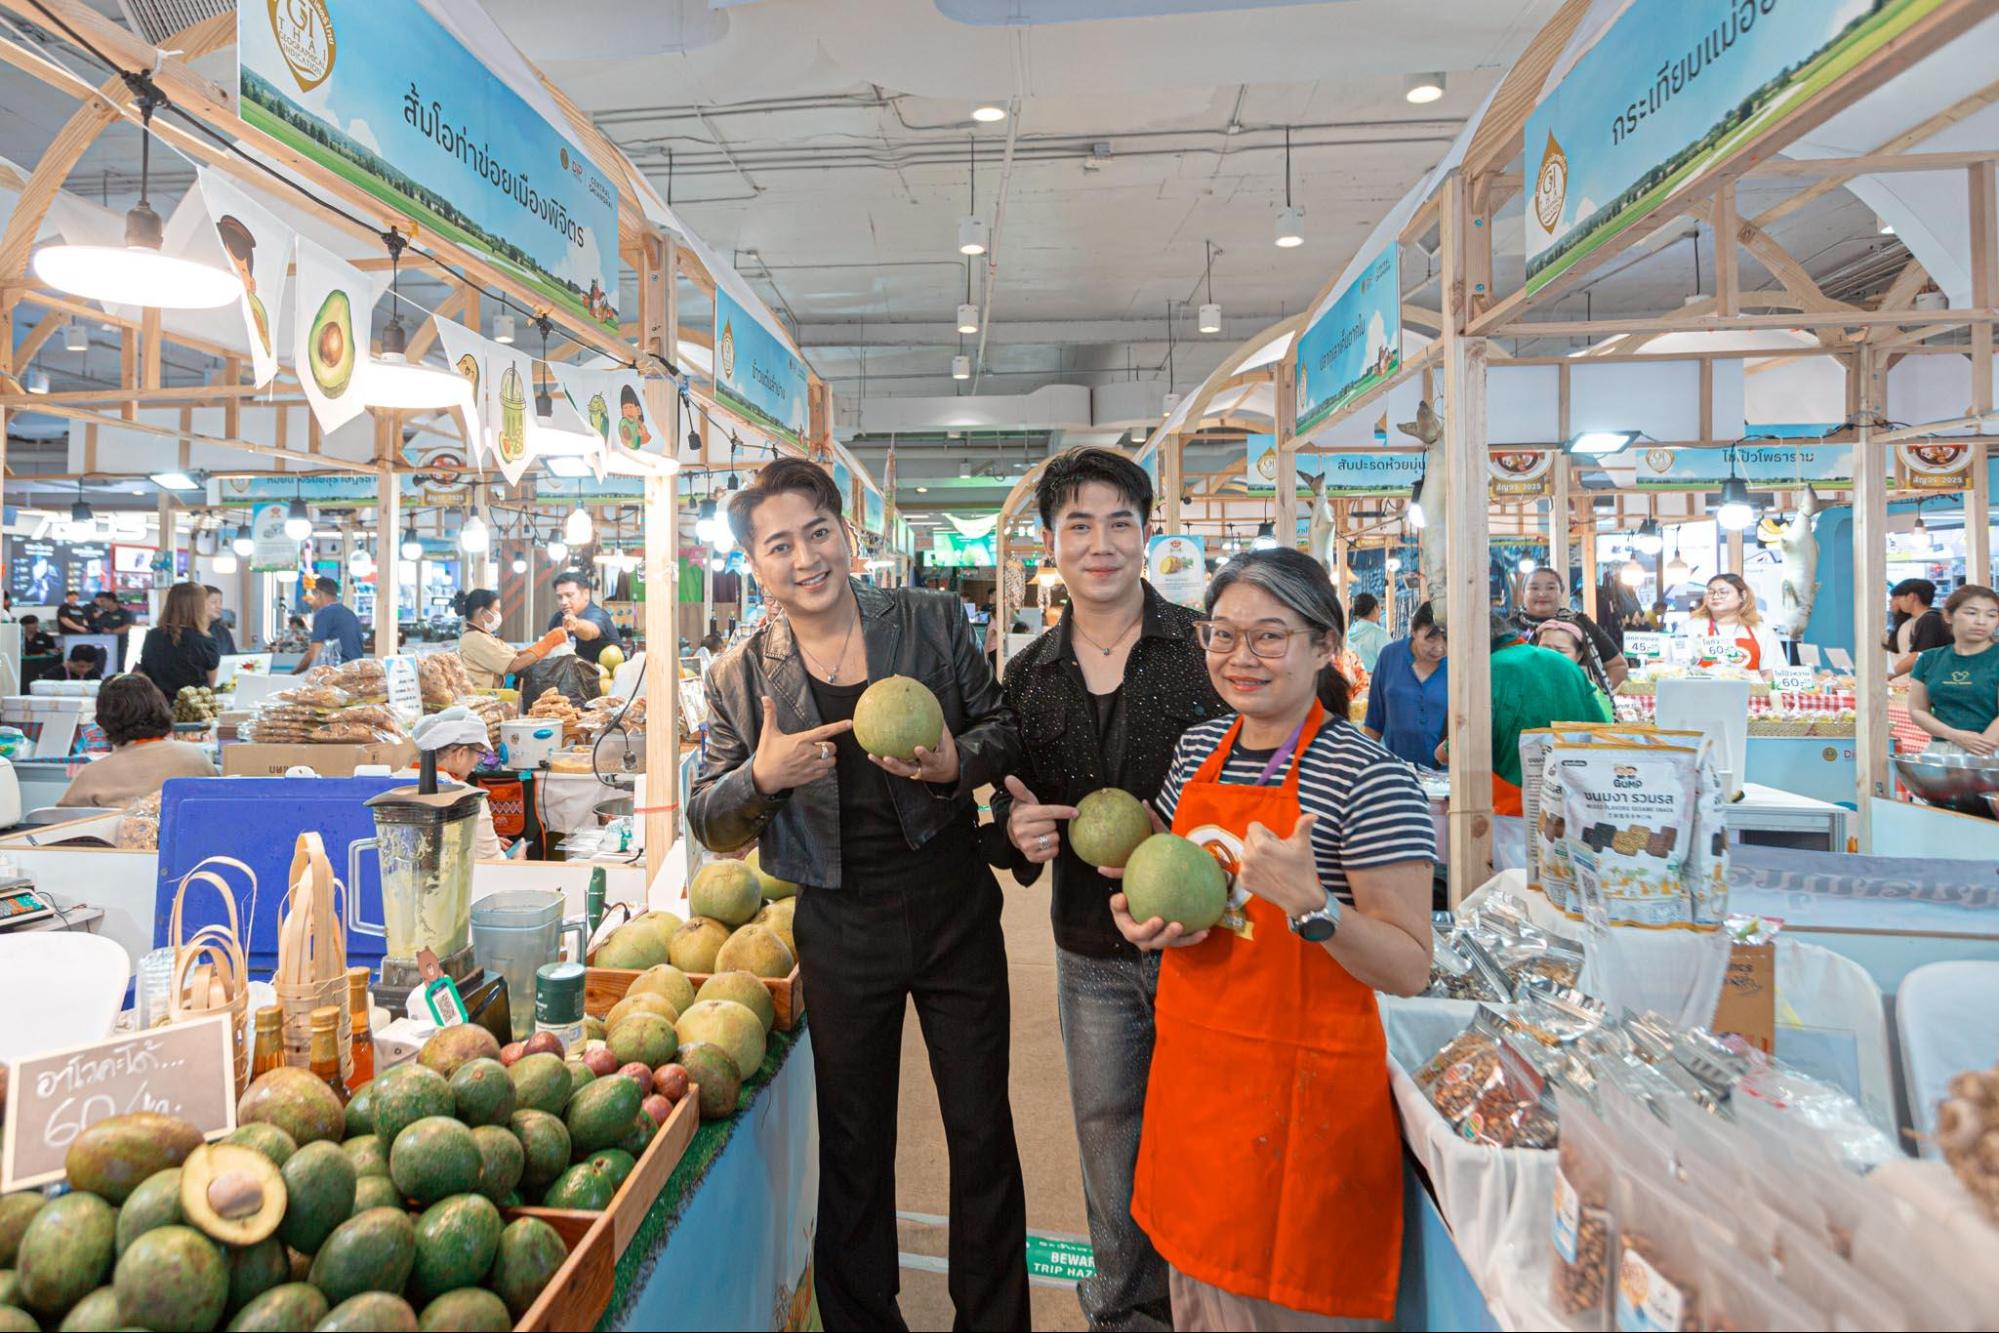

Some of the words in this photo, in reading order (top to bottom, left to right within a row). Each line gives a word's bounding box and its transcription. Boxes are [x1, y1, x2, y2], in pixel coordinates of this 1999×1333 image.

[402, 81, 585, 248] ส้มโอท่าข่อยเมืองพิจิตร
[1613, 779, 1643, 789] GUMP
[1584, 791, 1628, 804] ขนมงา
[1632, 793, 1674, 806] รวมรส
[1050, 1251, 1096, 1269] BEWAR
[1033, 1262, 1064, 1276] TRIP
[1067, 1267, 1097, 1279] HAZ
